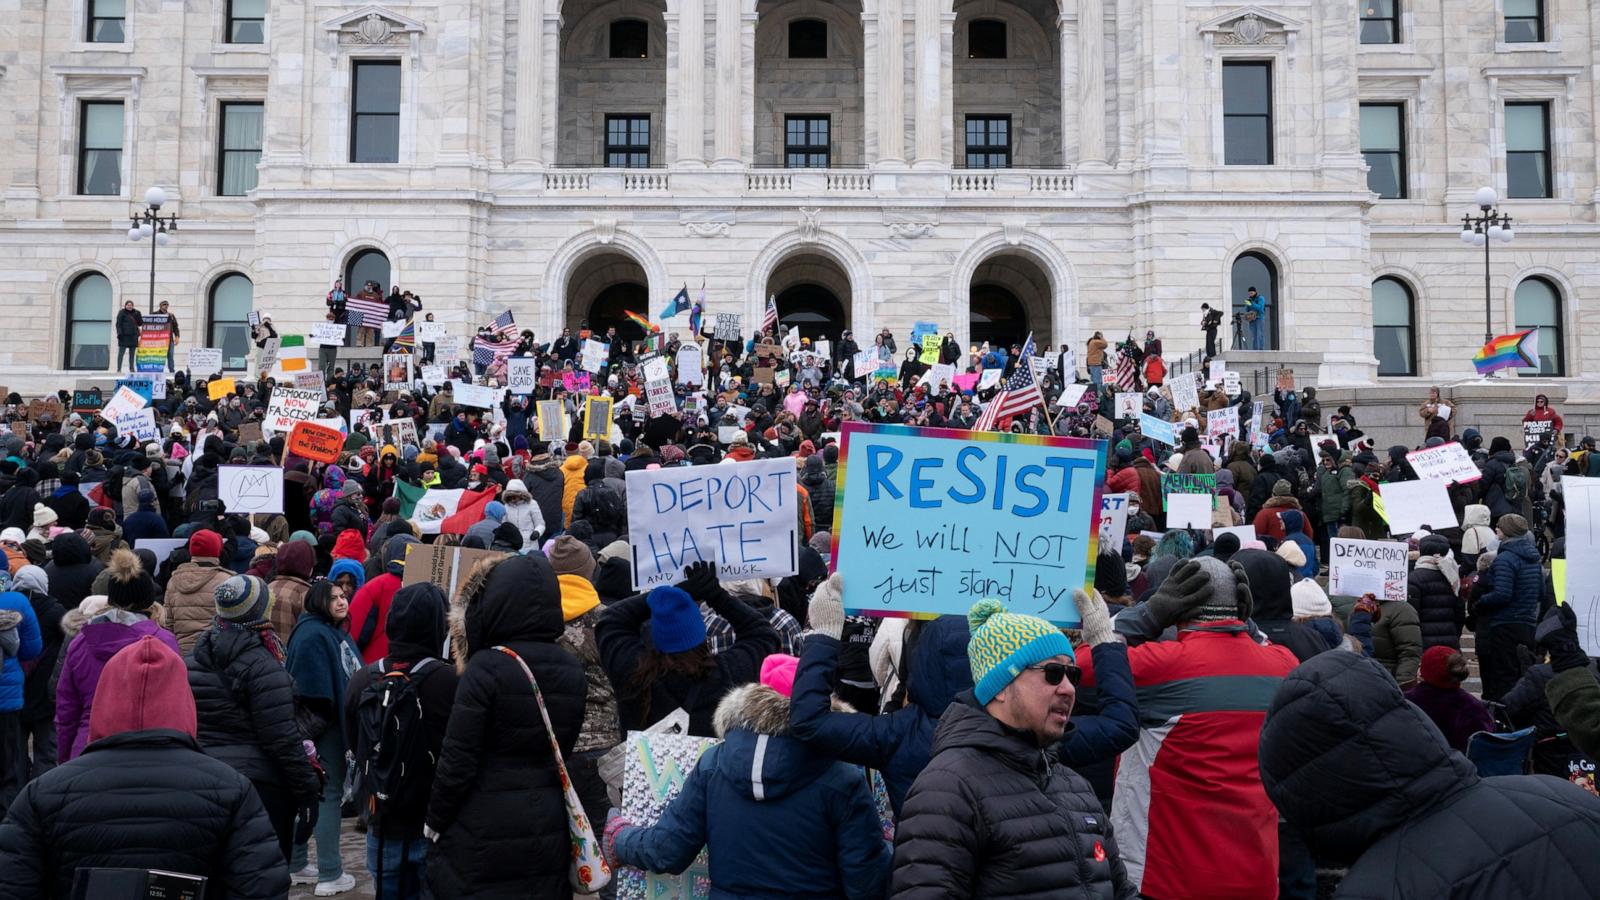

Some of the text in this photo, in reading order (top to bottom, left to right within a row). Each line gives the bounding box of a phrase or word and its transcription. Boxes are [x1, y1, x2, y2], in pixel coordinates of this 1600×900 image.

[512, 366, 531, 376] SAVE
[510, 377, 533, 387] USAID
[273, 387, 322, 400] DEMOCRACY
[284, 399, 308, 409] NOW
[268, 406, 316, 421] FASCISM
[276, 418, 296, 426] NEV
[1523, 420, 1552, 428] PROJECT
[866, 444, 1095, 518] RESIST
[652, 471, 791, 514] DEPORT
[648, 520, 767, 573] HATE
[862, 523, 1078, 561] We will NOT
[1334, 543, 1407, 566] DEMOCRACY
[720, 564, 762, 576] MUSK
[1354, 560, 1377, 569] OVER
[647, 572, 674, 584] AND
[874, 566, 1066, 614] just stand by
